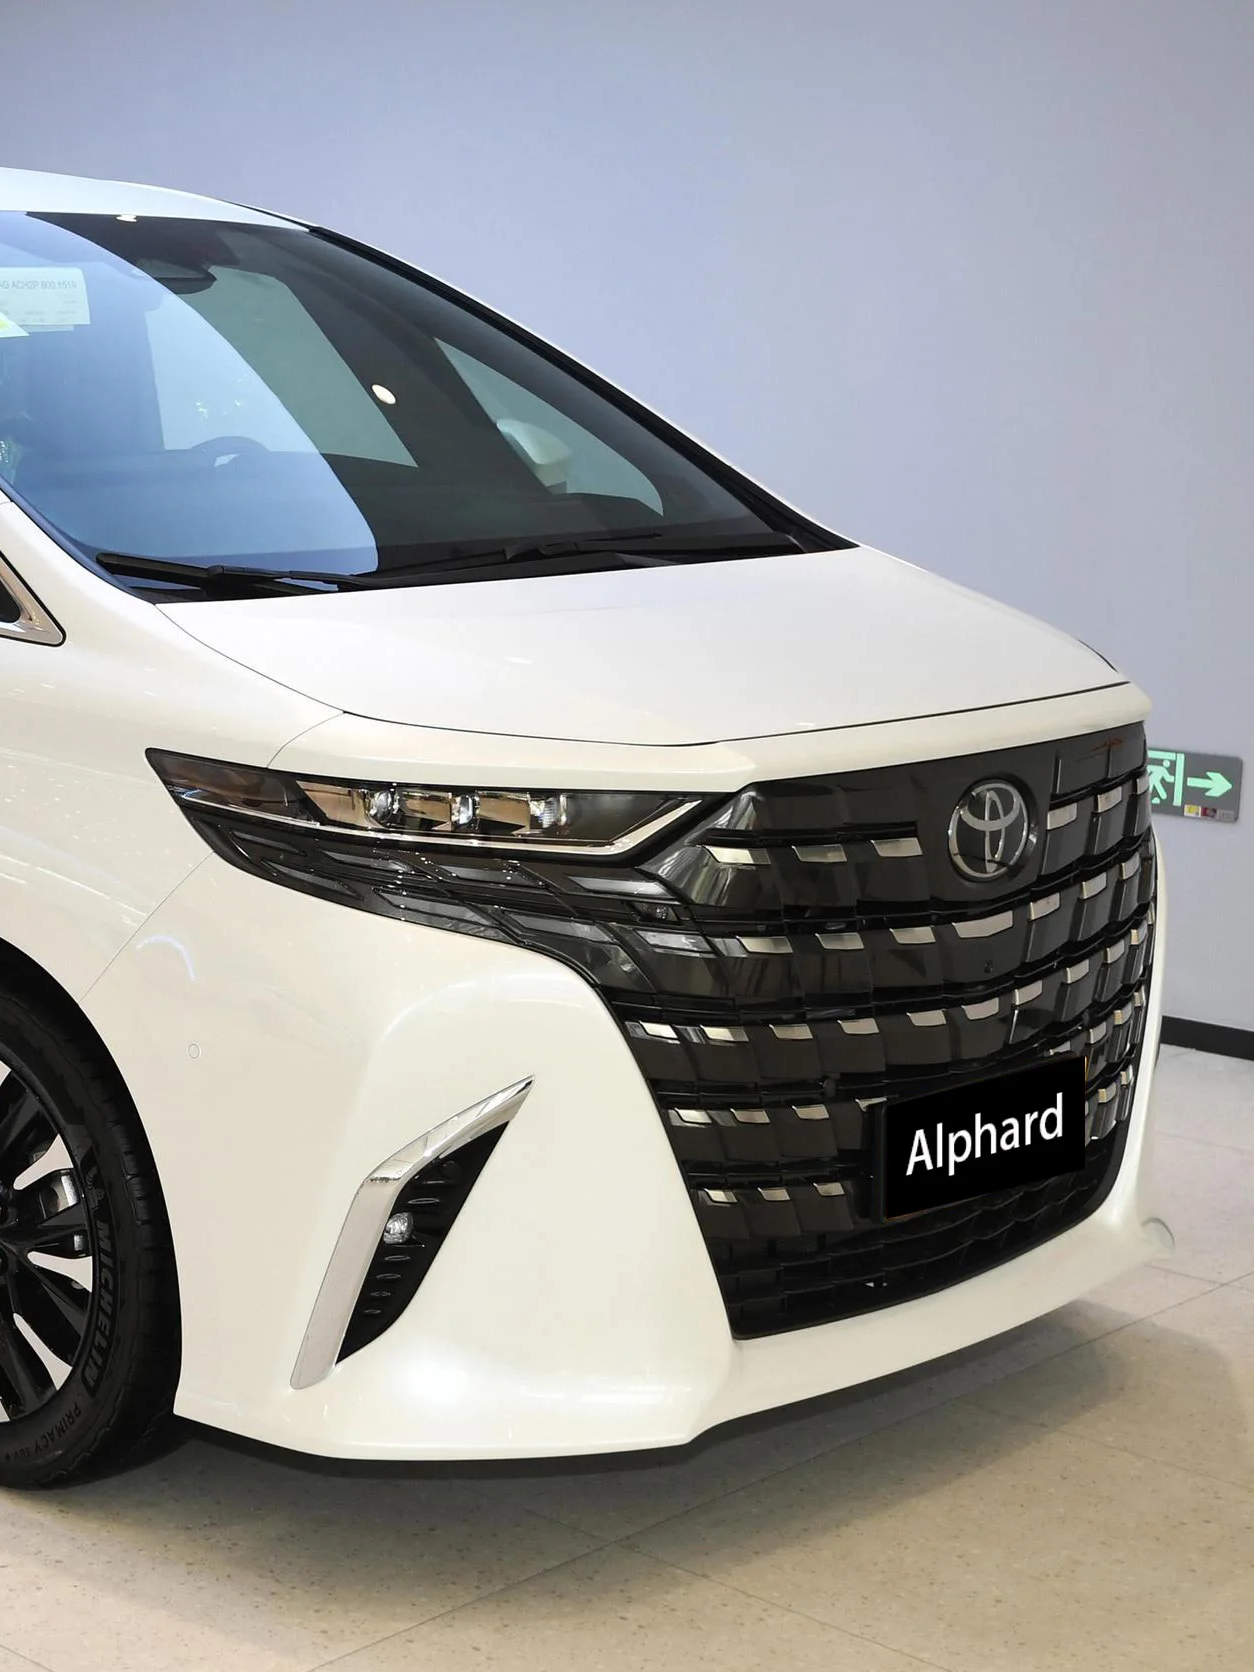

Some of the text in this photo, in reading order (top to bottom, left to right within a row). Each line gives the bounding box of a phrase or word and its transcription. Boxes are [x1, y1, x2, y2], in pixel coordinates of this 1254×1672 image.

[905, 1092, 1064, 1177] Alphard
[83, 1219, 115, 1388] MICHELIN
[35, 1402, 82, 1453] PRIMACY
